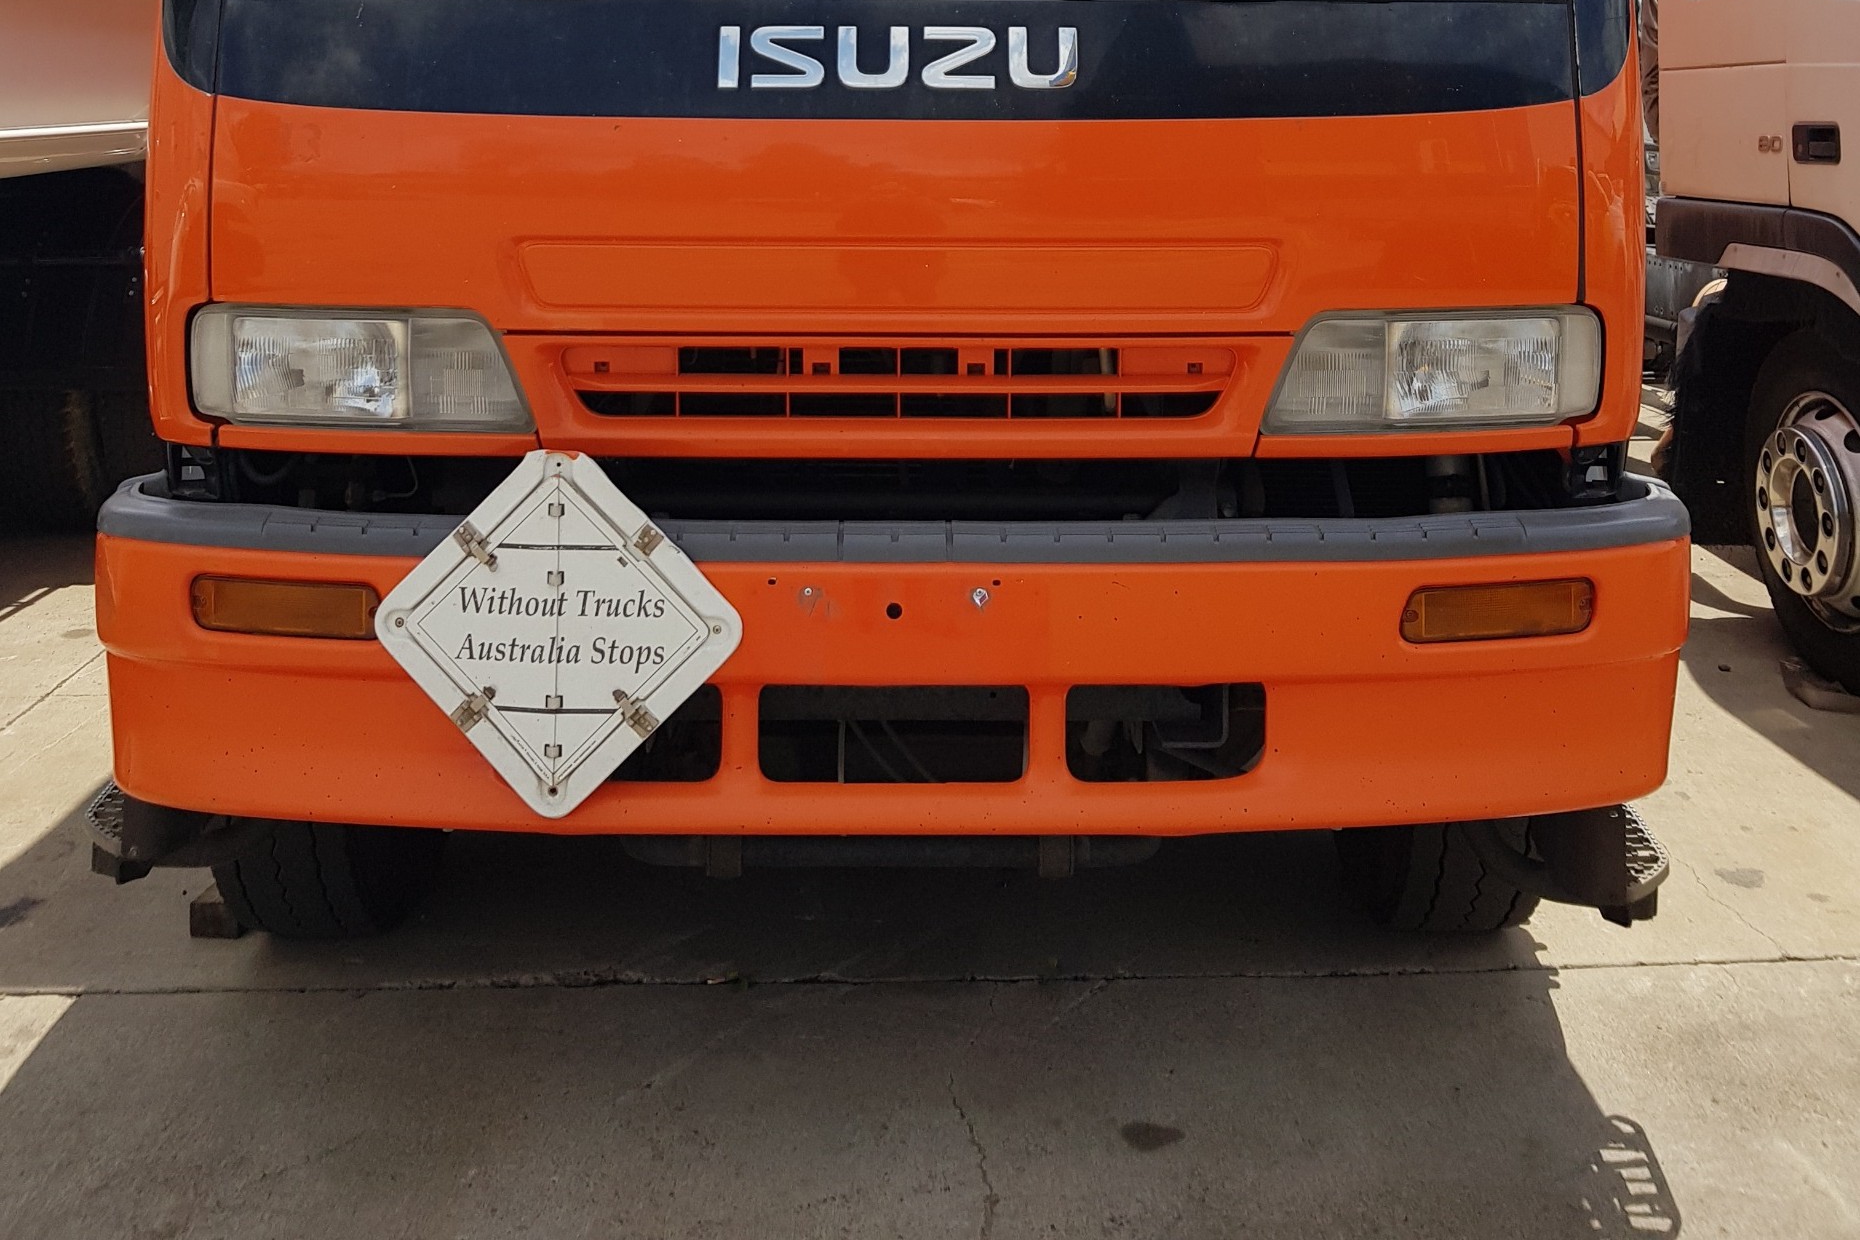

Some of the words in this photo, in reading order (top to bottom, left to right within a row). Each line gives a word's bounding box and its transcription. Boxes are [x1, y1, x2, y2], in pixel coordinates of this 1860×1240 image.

[718, 26, 1078, 89] ISUZU
[458, 586, 568, 616] Without
[576, 589, 666, 619] Trucks
[455, 633, 581, 664] Australia
[589, 636, 666, 674] Stops
